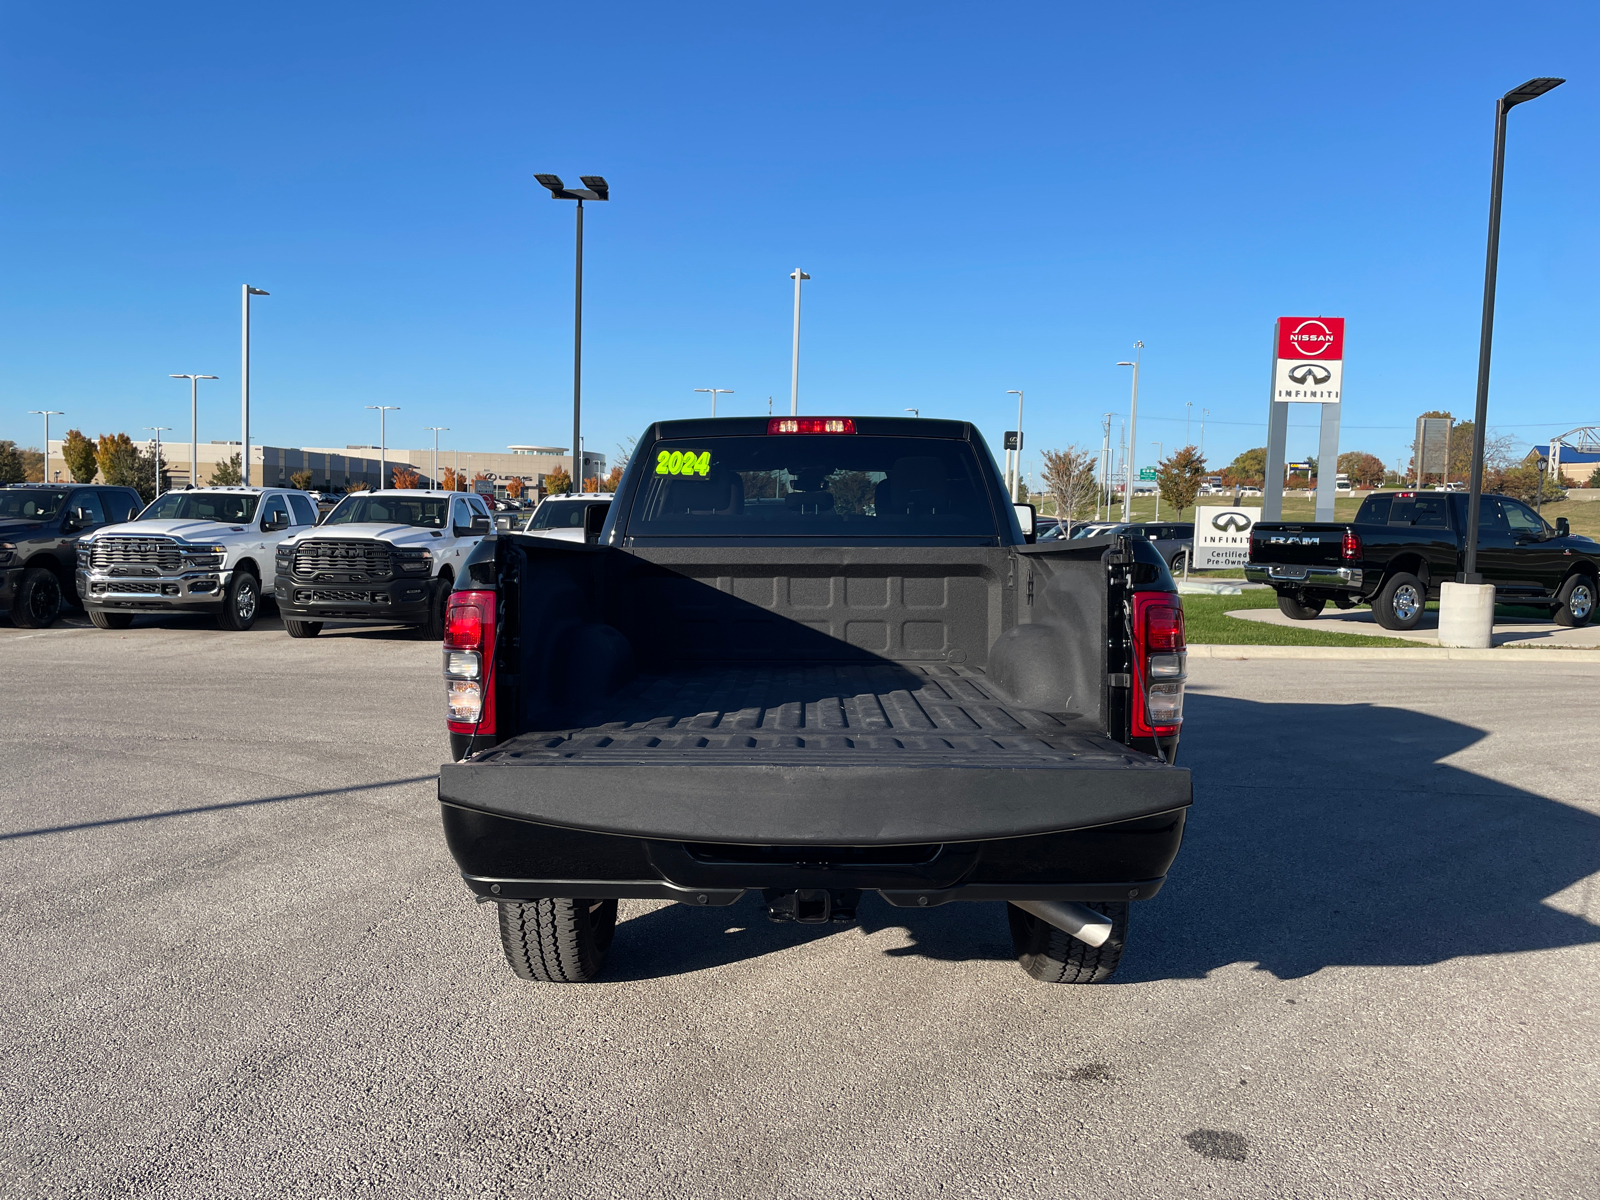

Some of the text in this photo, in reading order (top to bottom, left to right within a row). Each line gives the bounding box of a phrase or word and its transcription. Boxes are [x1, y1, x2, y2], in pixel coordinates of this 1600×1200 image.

[1290, 334, 1334, 342] NISSAN
[1278, 390, 1339, 398] INFINITI
[655, 450, 711, 476] 2024
[1270, 536, 1320, 546] RAM
[1211, 550, 1248, 558] Certified
[1206, 558, 1250, 566] Pre-Owne
